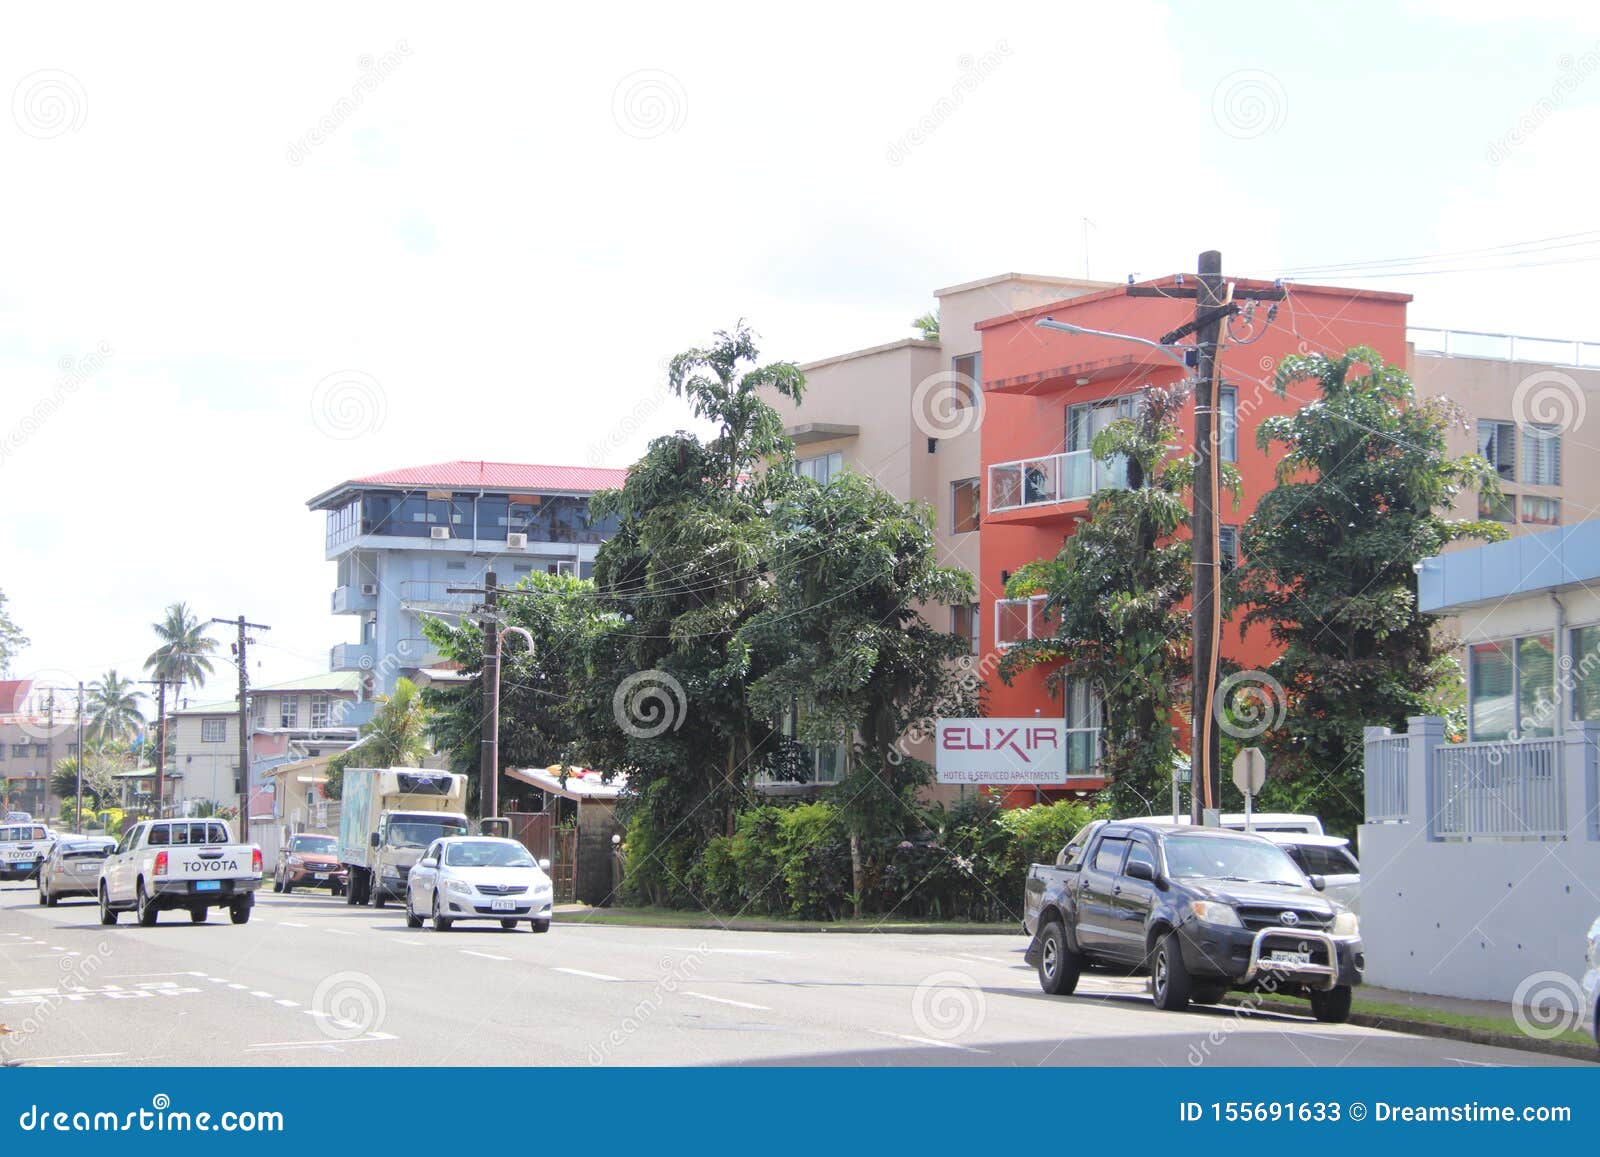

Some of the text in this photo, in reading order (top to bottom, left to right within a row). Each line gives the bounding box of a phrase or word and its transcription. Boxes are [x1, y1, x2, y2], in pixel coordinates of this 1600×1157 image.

[943, 728, 1058, 762] ELIXIR
[943, 771, 966, 780] HOTEL
[975, 771, 1009, 780] SERVICED
[1011, 771, 1060, 780] APARTMENTS
[183, 861, 238, 872] TOYOTA
